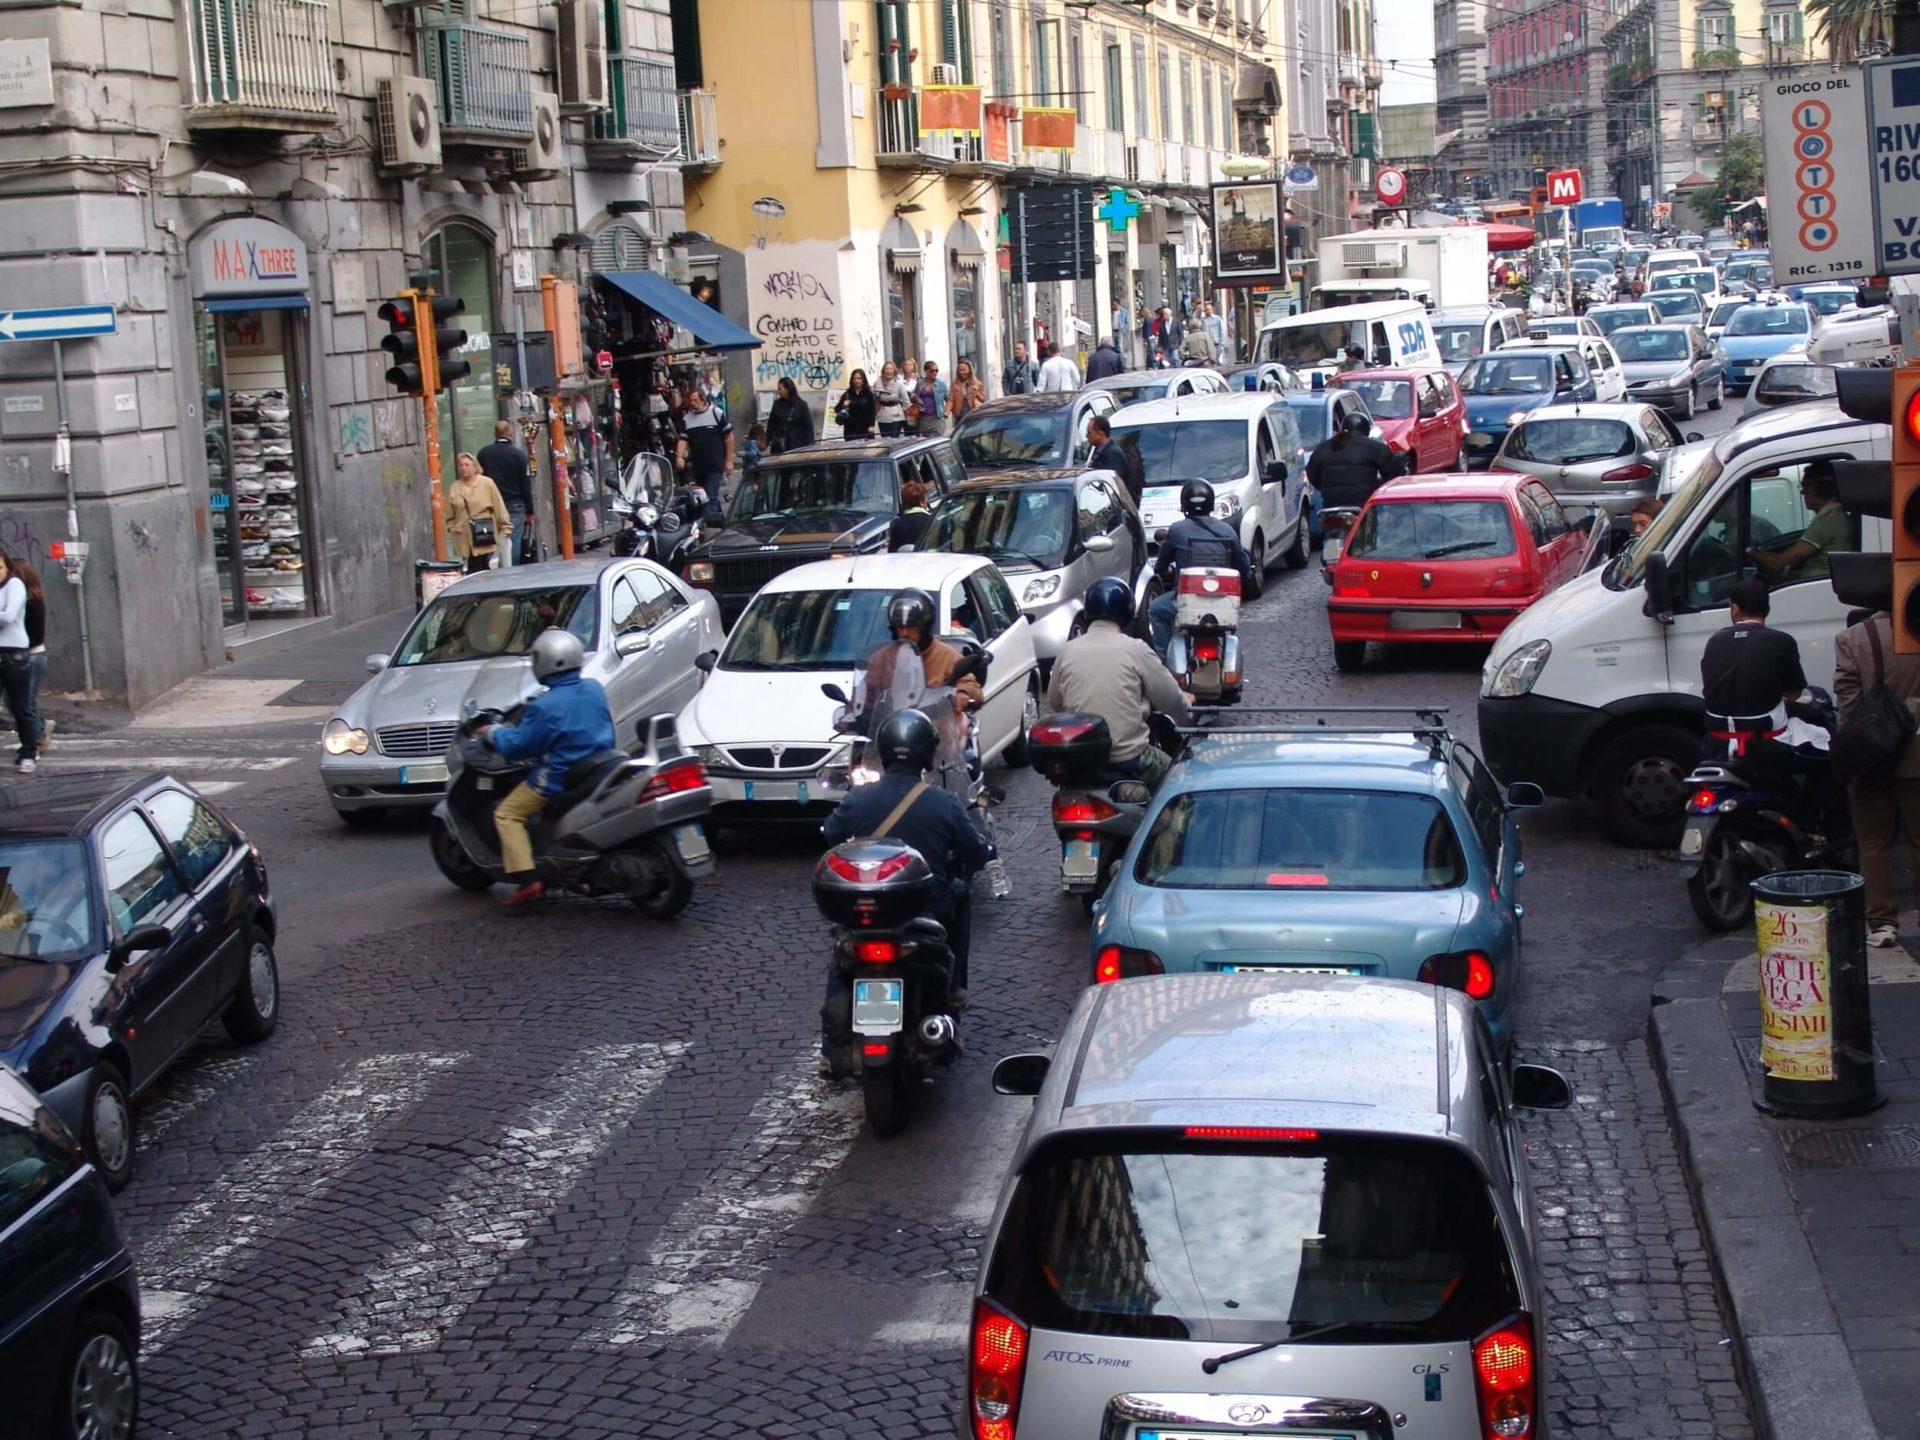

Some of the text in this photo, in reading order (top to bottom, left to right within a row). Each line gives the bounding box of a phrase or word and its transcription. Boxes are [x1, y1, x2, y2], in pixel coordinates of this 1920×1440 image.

[1777, 79, 1850, 95] GIOCO DEL
[1553, 178, 1576, 198] M
[1893, 216, 1920, 236] V
[1789, 260, 1863, 276] RIC. 1318
[814, 318, 833, 331] LO
[775, 333, 838, 348] STATO E
[1398, 320, 1426, 355] SDA
[776, 350, 844, 366] CAPITALE
[1769, 909, 1797, 937] 26
[1043, 1350, 1133, 1368] ATOS PRIME
